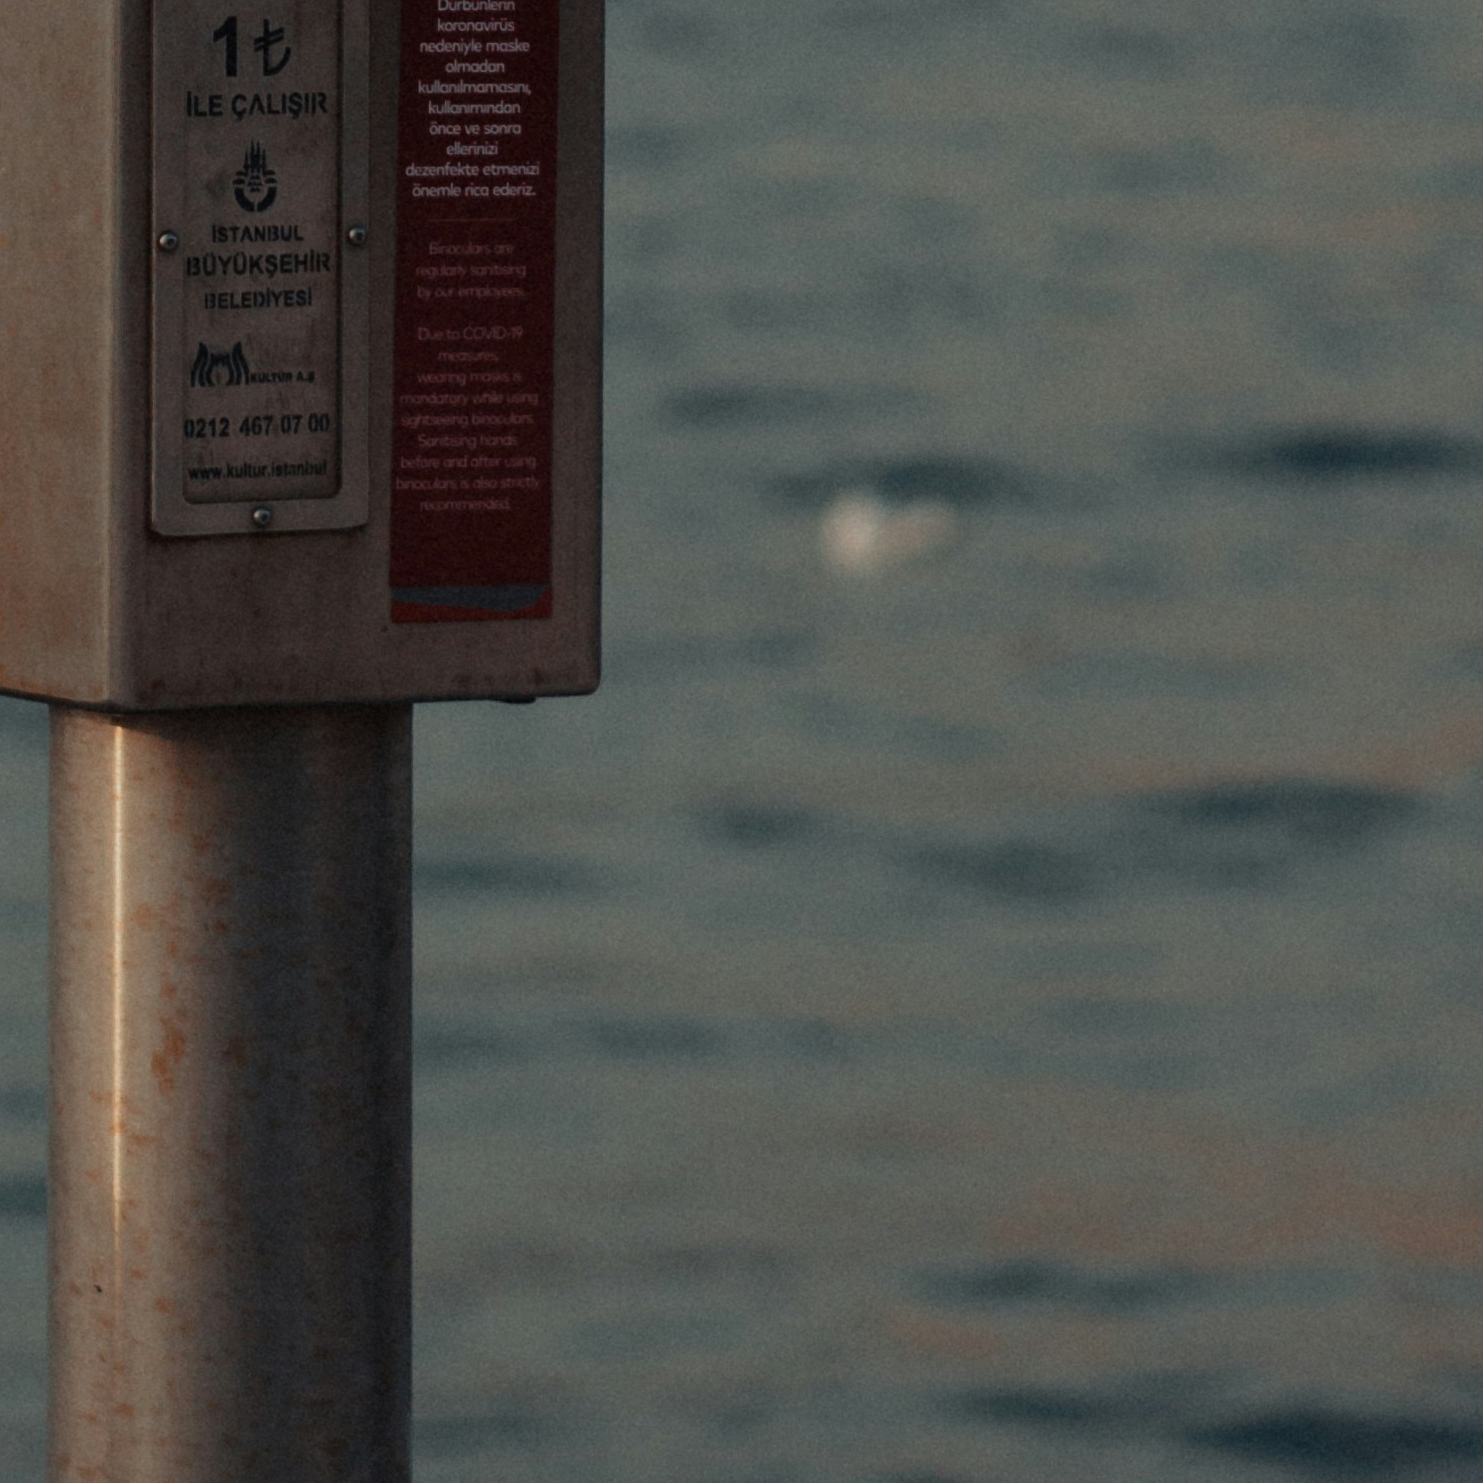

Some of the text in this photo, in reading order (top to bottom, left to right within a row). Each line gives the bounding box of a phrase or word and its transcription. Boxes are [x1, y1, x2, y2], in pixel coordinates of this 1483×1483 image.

[437, 18, 515, 32] koronavirüs
[420, 38, 530, 56] nedeniyle maske
[445, 59, 505, 73] olmadan
[186, 90, 328, 121] İLE ÇALIŞIR
[428, 100, 521, 115] kullanımından
[429, 122, 522, 135] önce ve sonra
[446, 141, 499, 156] ellerinizi
[405, 161, 541, 177] dezenfekte etmenizi
[412, 181, 536, 197] önemle rica ederiz.
[211, 224, 304, 244] İSTANBUL
[186, 248, 331, 278] BÜYÜKŞEHİR
[204, 286, 313, 311] BELEDİYESİ
[417, 327, 444, 341] Due
[183, 412, 331, 439] 0212 467 07 00
[188, 460, 328, 481] www.kultur.istanbul
